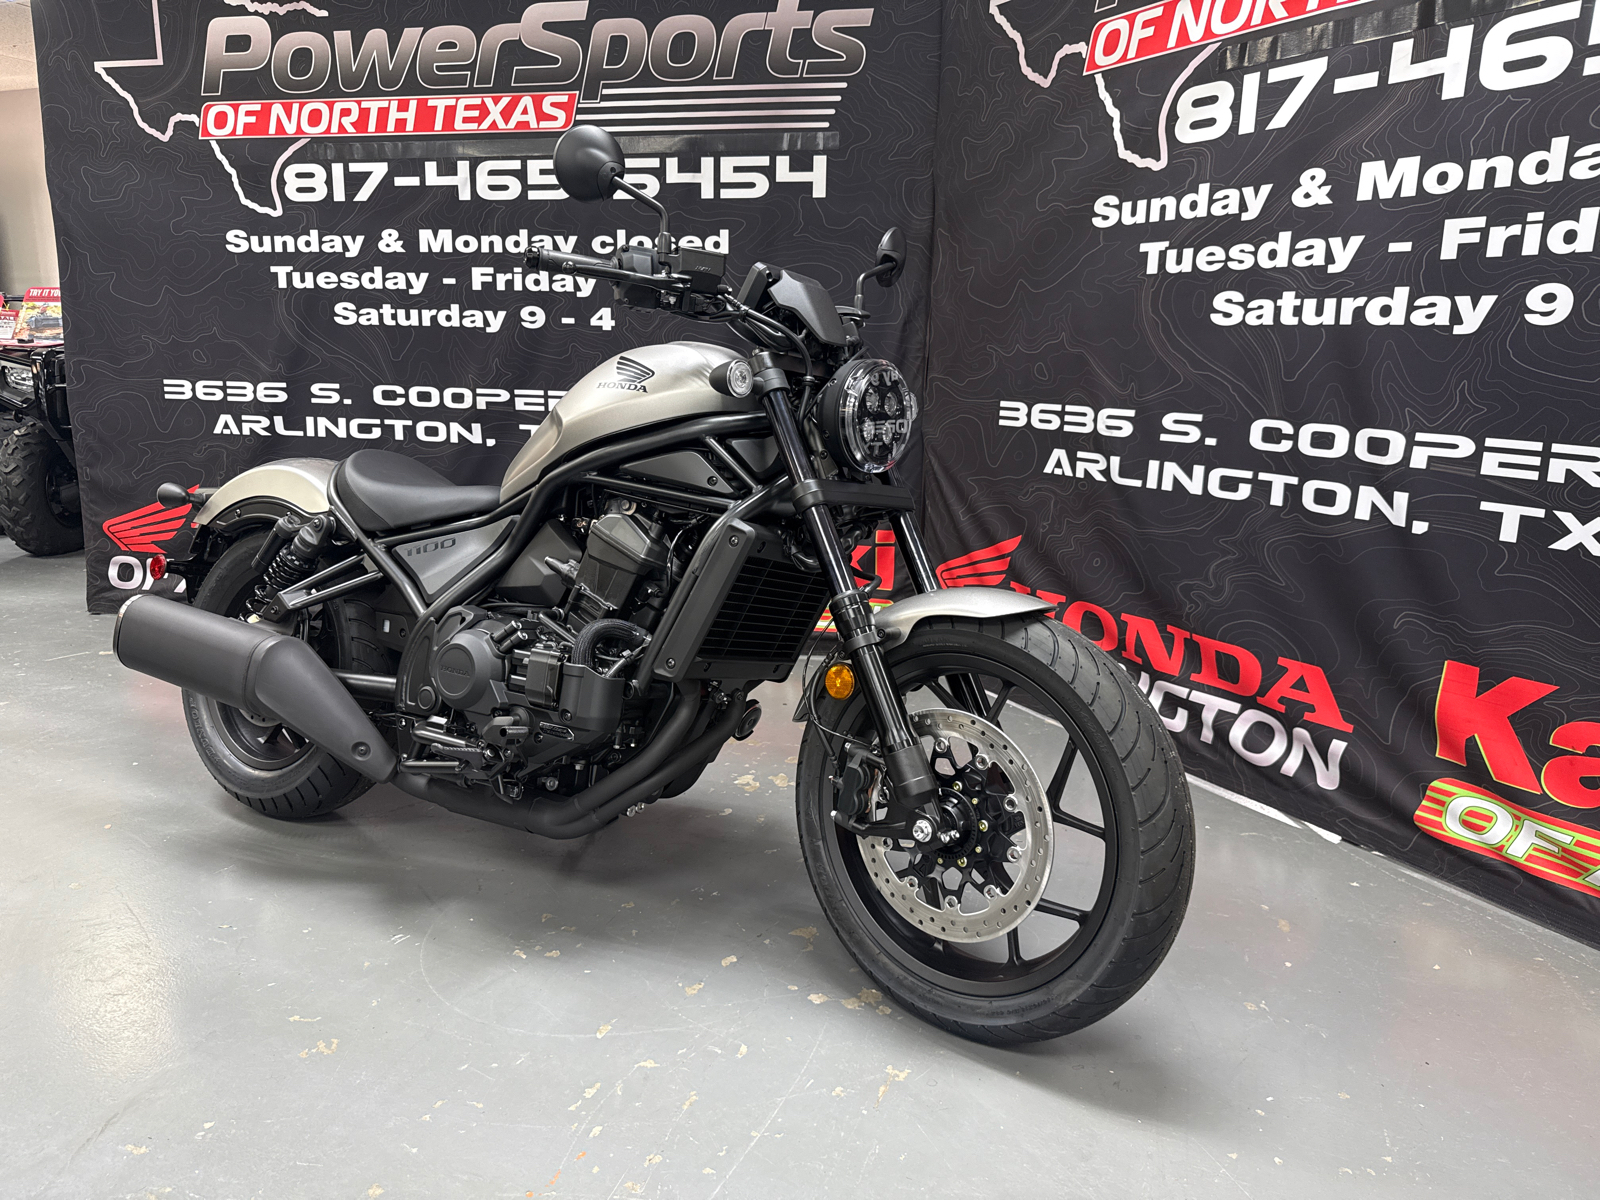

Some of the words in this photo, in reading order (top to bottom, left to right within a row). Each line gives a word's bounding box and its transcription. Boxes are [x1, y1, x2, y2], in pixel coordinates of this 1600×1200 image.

[200, 0, 875, 103] PowerSports
[1093, 11, 1159, 65] OF
[1166, 0, 1342, 49] NOR
[206, 103, 262, 137] OF
[268, 99, 419, 135] NORTH
[427, 95, 569, 131] TEXAS
[284, 158, 828, 202] 817-4655454
[1092, 183, 1273, 228] Sunday
[1292, 168, 1333, 207] &
[226, 230, 364, 257] Sunday
[378, 229, 405, 253] &
[1140, 231, 1365, 274] Tuesday
[1388, 242, 1412, 252] -
[270, 266, 429, 294] Tuesday
[471, 267, 597, 298] Friday
[334, 302, 506, 332] Saturday
[520, 306, 545, 328] 9
[590, 308, 615, 330] 4
[1210, 287, 1498, 334] Saturday
[1524, 283, 1574, 325] 9
[163, 379, 288, 402] 3636
[311, 383, 351, 404] S.
[596, 381, 649, 394] HONDA
[213, 414, 495, 446] ARLINGTON,
[999, 401, 1135, 437] 3636
[1160, 413, 1216, 445] S.
[1249, 419, 1600, 488] COOPER
[1043, 445, 1432, 534] ARLINGTON,
[1480, 501, 1600, 557] TX
[404, 537, 456, 557] 1100
[1445, 796, 1576, 858] OF
